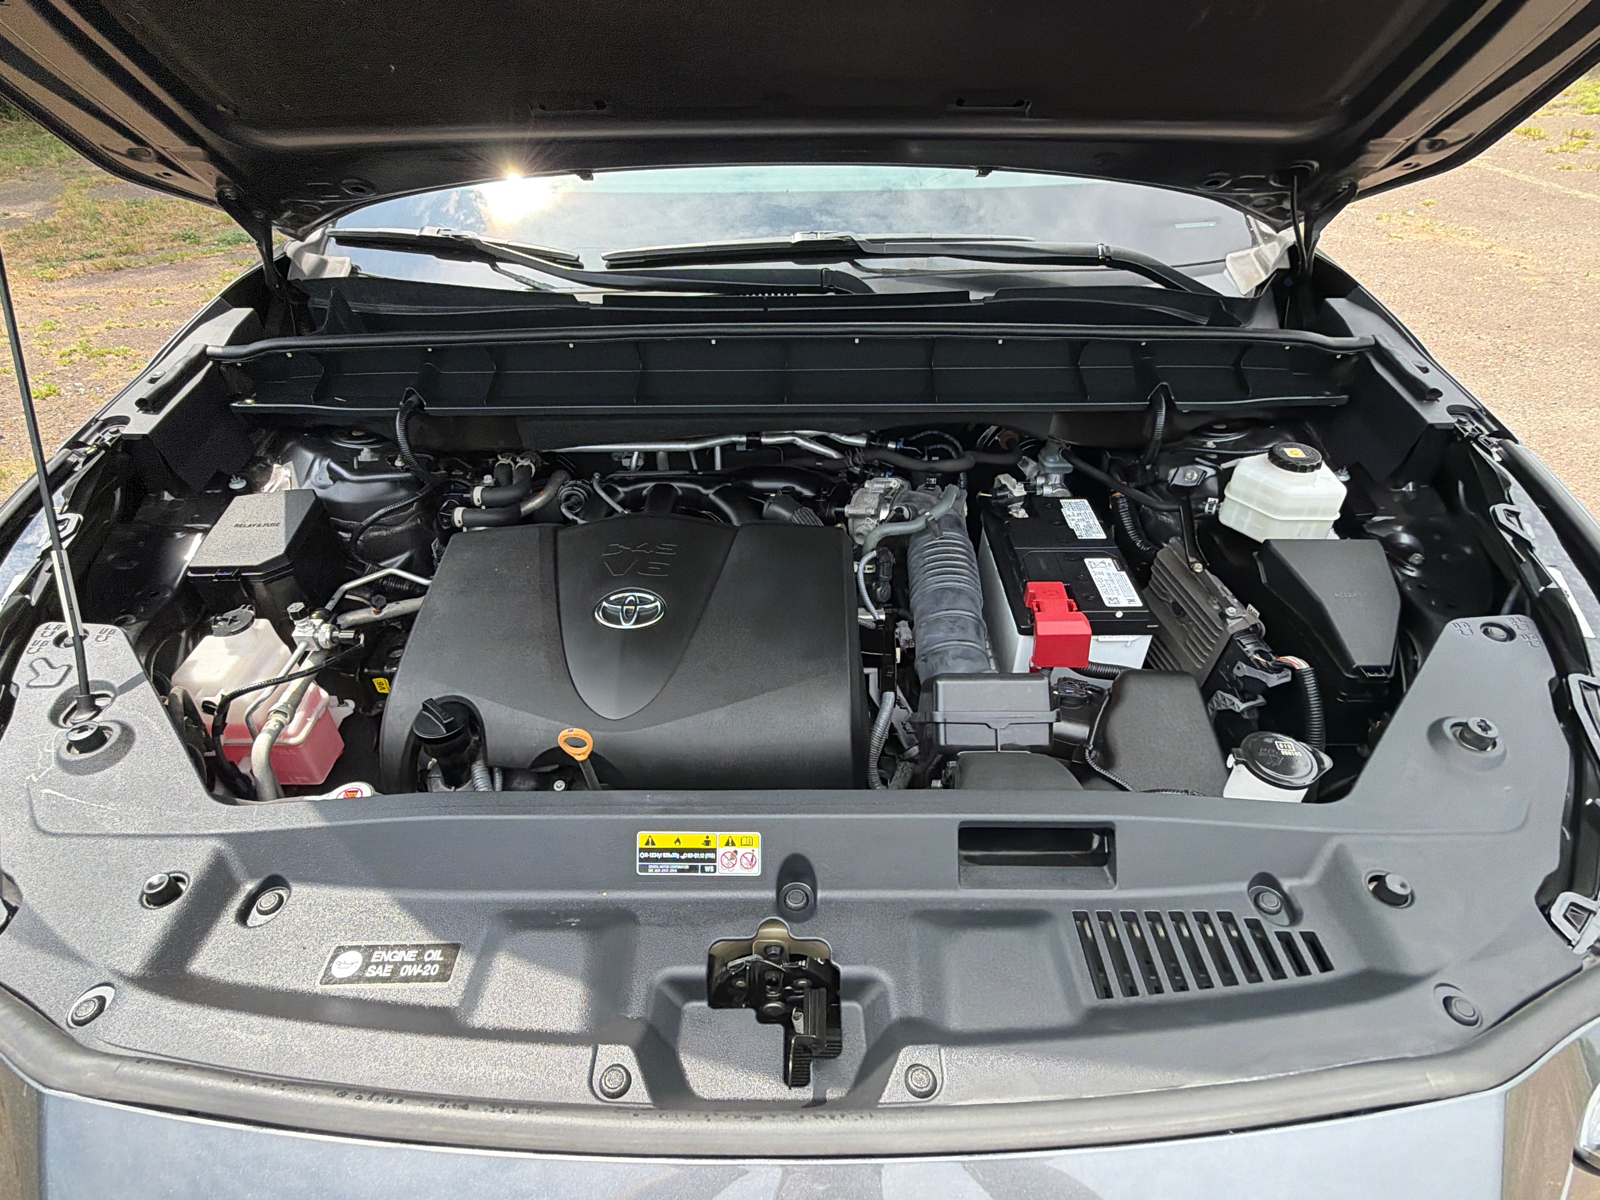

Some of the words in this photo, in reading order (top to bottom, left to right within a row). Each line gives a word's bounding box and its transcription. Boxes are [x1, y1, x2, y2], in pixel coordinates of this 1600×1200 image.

[603, 559, 670, 576] V6
[370, 950, 418, 963] ENGINE
[423, 949, 444, 962] OIL
[365, 964, 393, 977] SAE
[400, 964, 440, 977] 0W-20
